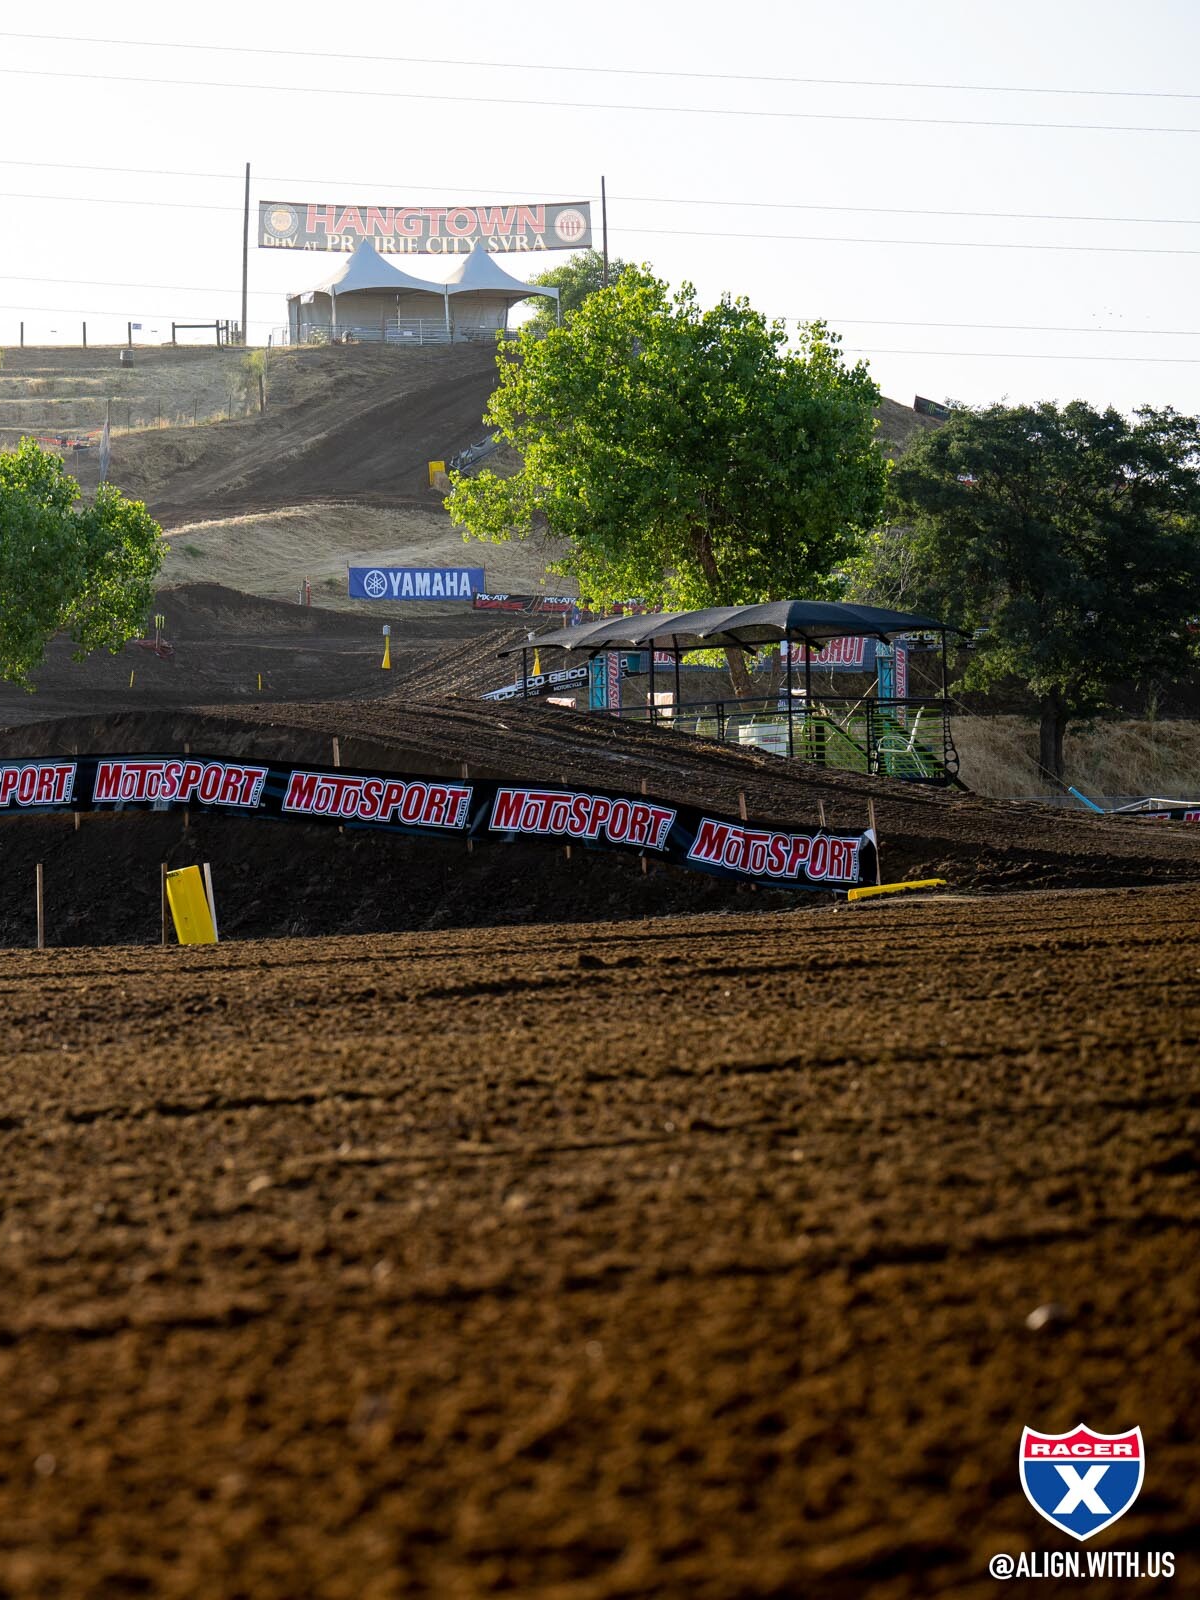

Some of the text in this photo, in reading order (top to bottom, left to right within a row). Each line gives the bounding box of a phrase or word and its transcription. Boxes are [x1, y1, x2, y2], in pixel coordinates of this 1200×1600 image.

[306, 204, 545, 237] HANGTOWN
[304, 241, 320, 250] AT
[327, 234, 418, 254] PRIRIE
[426, 236, 480, 254] CITY
[488, 234, 547, 253] SVRA
[389, 572, 471, 597] YAMAHA
[476, 593, 509, 601] MX-ATV
[550, 667, 588, 683] GEICO
[553, 682, 583, 692] MOTORCYCLE
